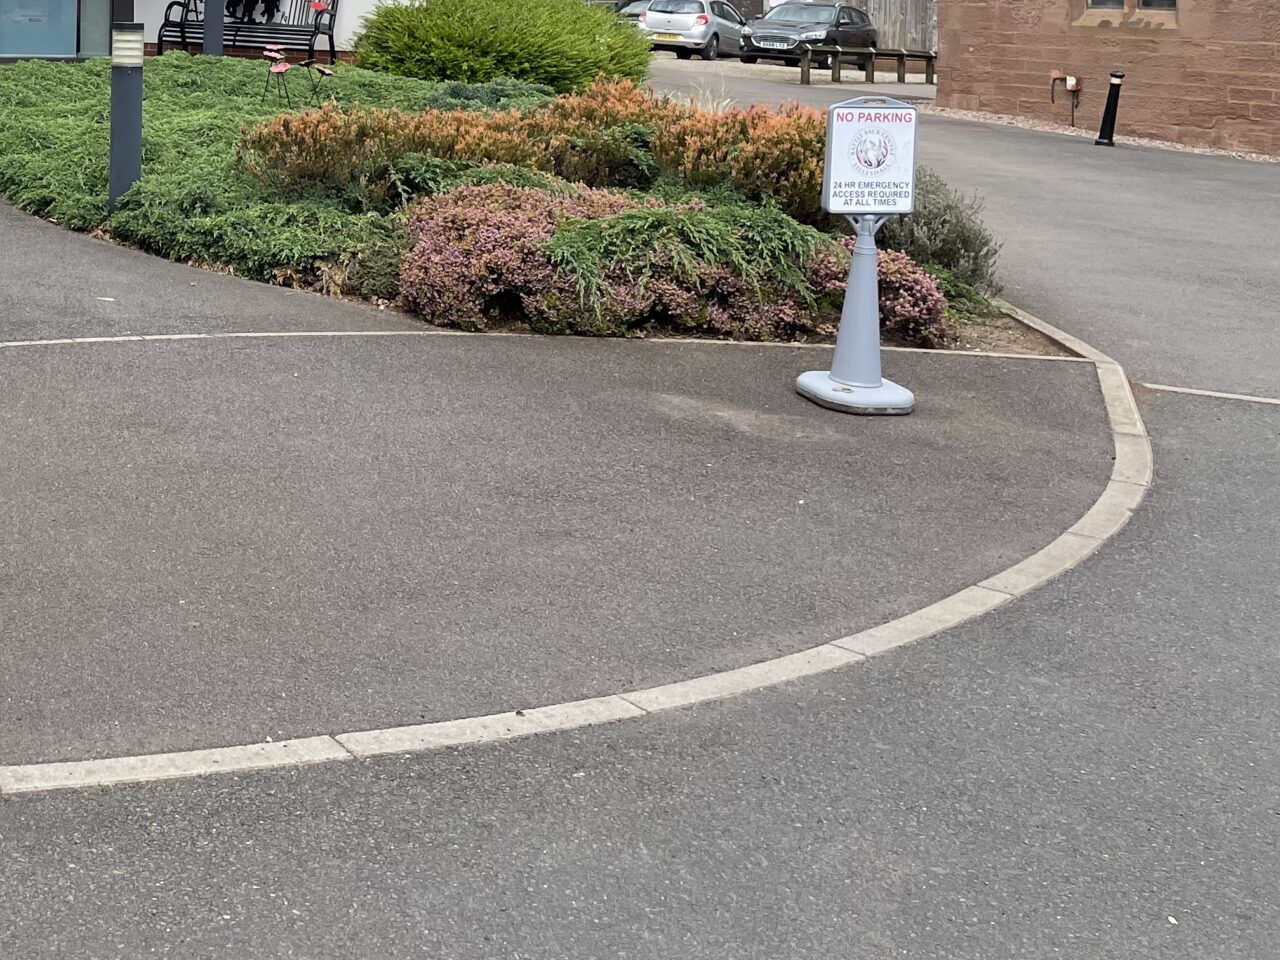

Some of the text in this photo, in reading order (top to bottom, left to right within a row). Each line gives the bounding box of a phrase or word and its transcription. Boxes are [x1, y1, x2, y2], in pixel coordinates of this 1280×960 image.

[836, 112, 913, 123] NO PARKING
[833, 181, 910, 189] 24 HR EMERGENCY
[832, 190, 910, 198] ACCESS REQUIRED
[843, 198, 897, 206] AT ALL TIMES
